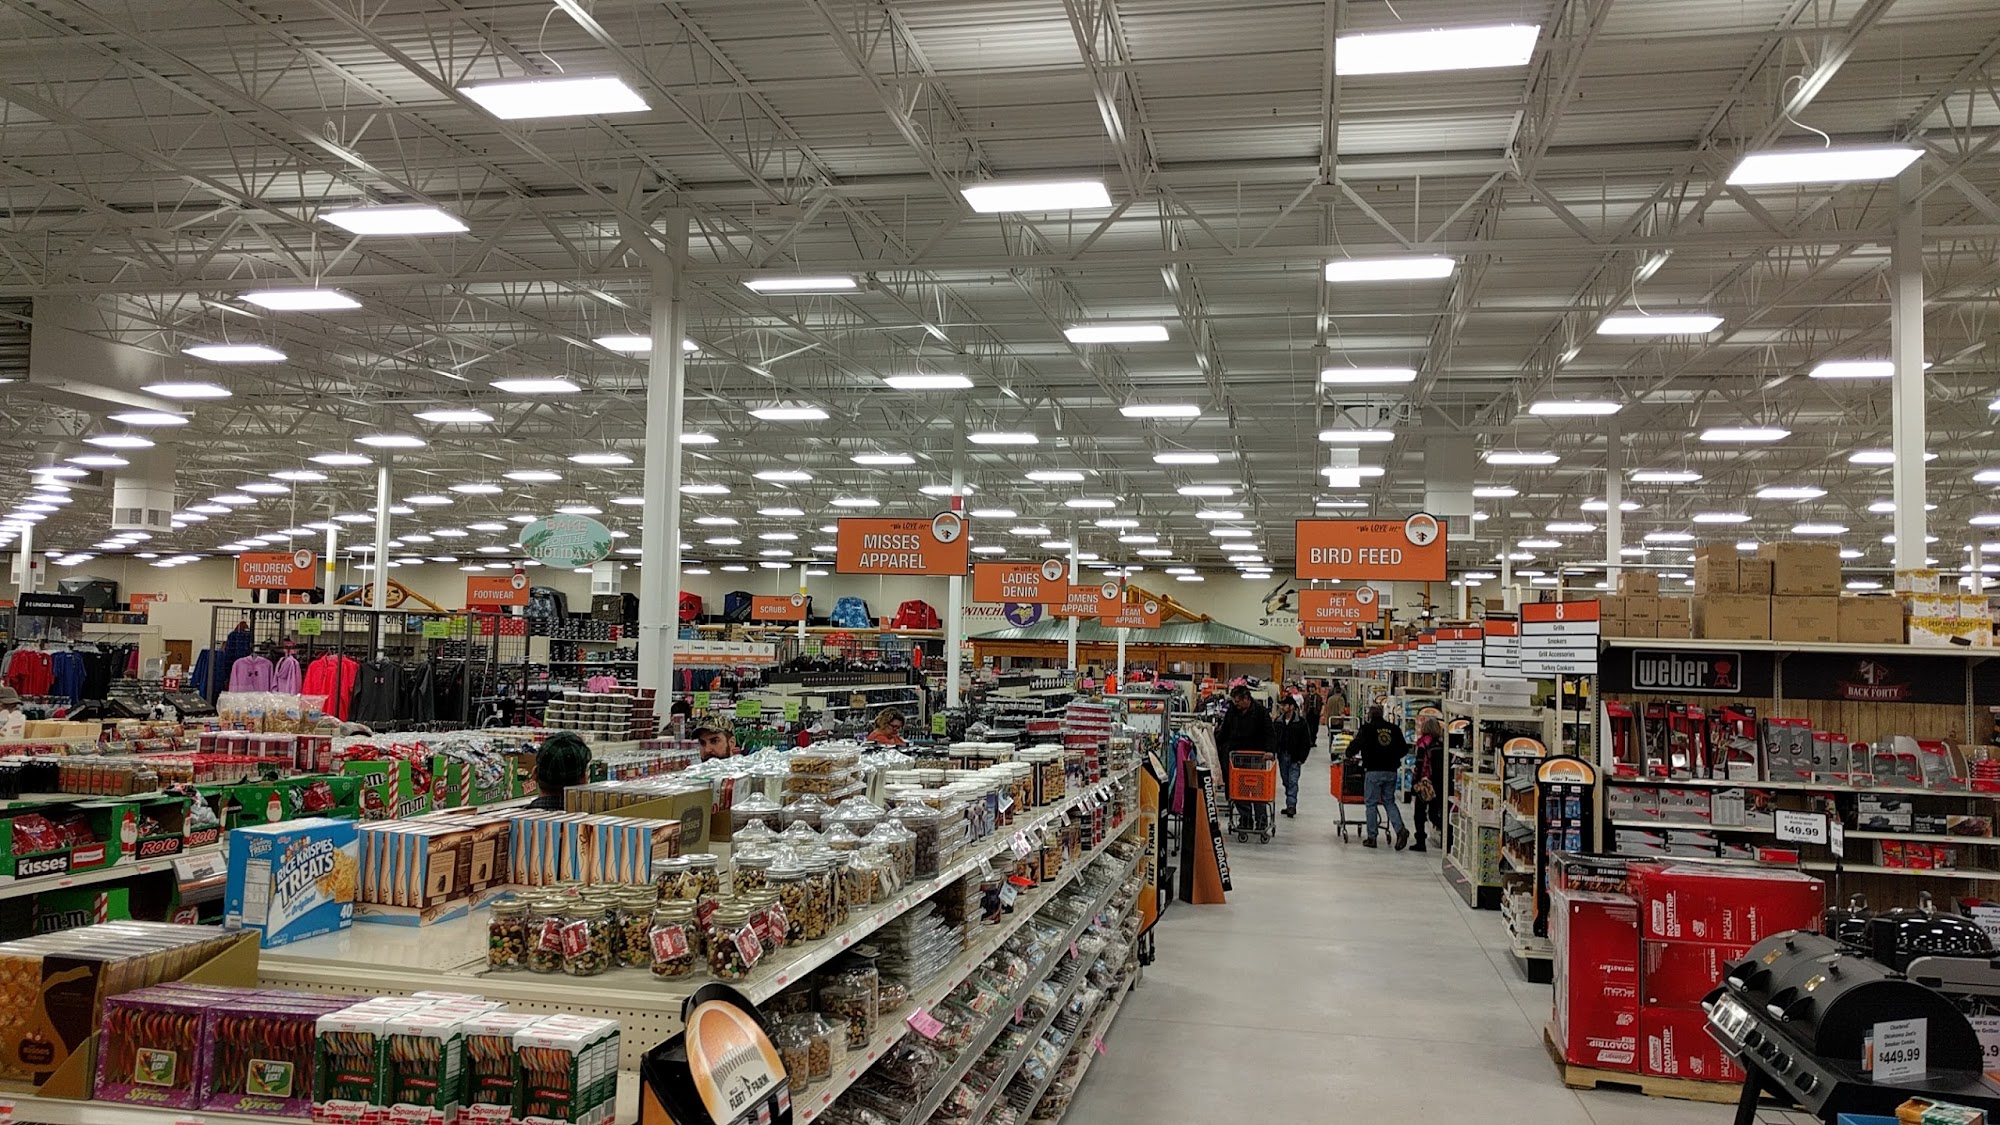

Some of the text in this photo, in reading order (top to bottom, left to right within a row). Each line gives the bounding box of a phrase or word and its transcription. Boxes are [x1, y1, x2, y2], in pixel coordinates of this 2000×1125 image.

[545, 519, 588, 532] BAKE
[1370, 524, 1387, 532] LOVE
[863, 534, 920, 550] MISSES
[534, 547, 598, 561] HOLIDAYS
[1309, 547, 1402, 565] BIRD FEED
[858, 552, 927, 569] APPAREL
[243, 562, 293, 573] CHILDRENS
[248, 575, 288, 586] APPAREL
[1001, 573, 1040, 584] LADIES
[473, 590, 514, 599] FOOTWEAR
[1002, 586, 1038, 598] DENIM
[1068, 593, 1098, 603] OMENS
[1329, 597, 1347, 606] PET
[760, 605, 787, 614] SCRUBS
[1060, 604, 1099, 614] APPAREL
[1122, 608, 1141, 616] TEAM
[1316, 608, 1360, 618] SUPPLIES
[1555, 604, 1564, 620] 8
[1115, 616, 1147, 625] APPAREL
[1453, 629, 1463, 639] 14
[961, 640, 973, 648] IVE
[1541, 664, 1556, 672] Turkey
[1848, 686, 1899, 698] BACK FORTY
[1203, 775, 1217, 823] DURACELL
[1784, 825, 1819, 836] $49.99
[276, 838, 334, 883] RICE KRISPIES
[1214, 837, 1231, 884] DURACELL
[277, 852, 335, 909] TREATS
[340, 903, 353, 919] 40
[1666, 892, 1675, 938] ROADTRIP
[339, 919, 352, 928] BARS
[1589, 1040, 1635, 1051] ROADTRIP
[1663, 1028, 1673, 1074] ROADTRIP
[151, 1053, 169, 1064] FLAVOR
[1604, 1051, 1632, 1063] Coleman
[1879, 1047, 1920, 1065] $449.99
[151, 1062, 166, 1072] KICK!
[264, 1064, 286, 1074] FLAVOR
[264, 1073, 282, 1083] KICK!
[125, 1087, 169, 1102] Spree
[728, 1073, 771, 1112] FLEET FARM
[234, 1097, 285, 1112] Spree
[326, 1101, 364, 1114] Spangler
[392, 1105, 429, 1119] Spangler
[472, 1105, 509, 1118] Spangler
